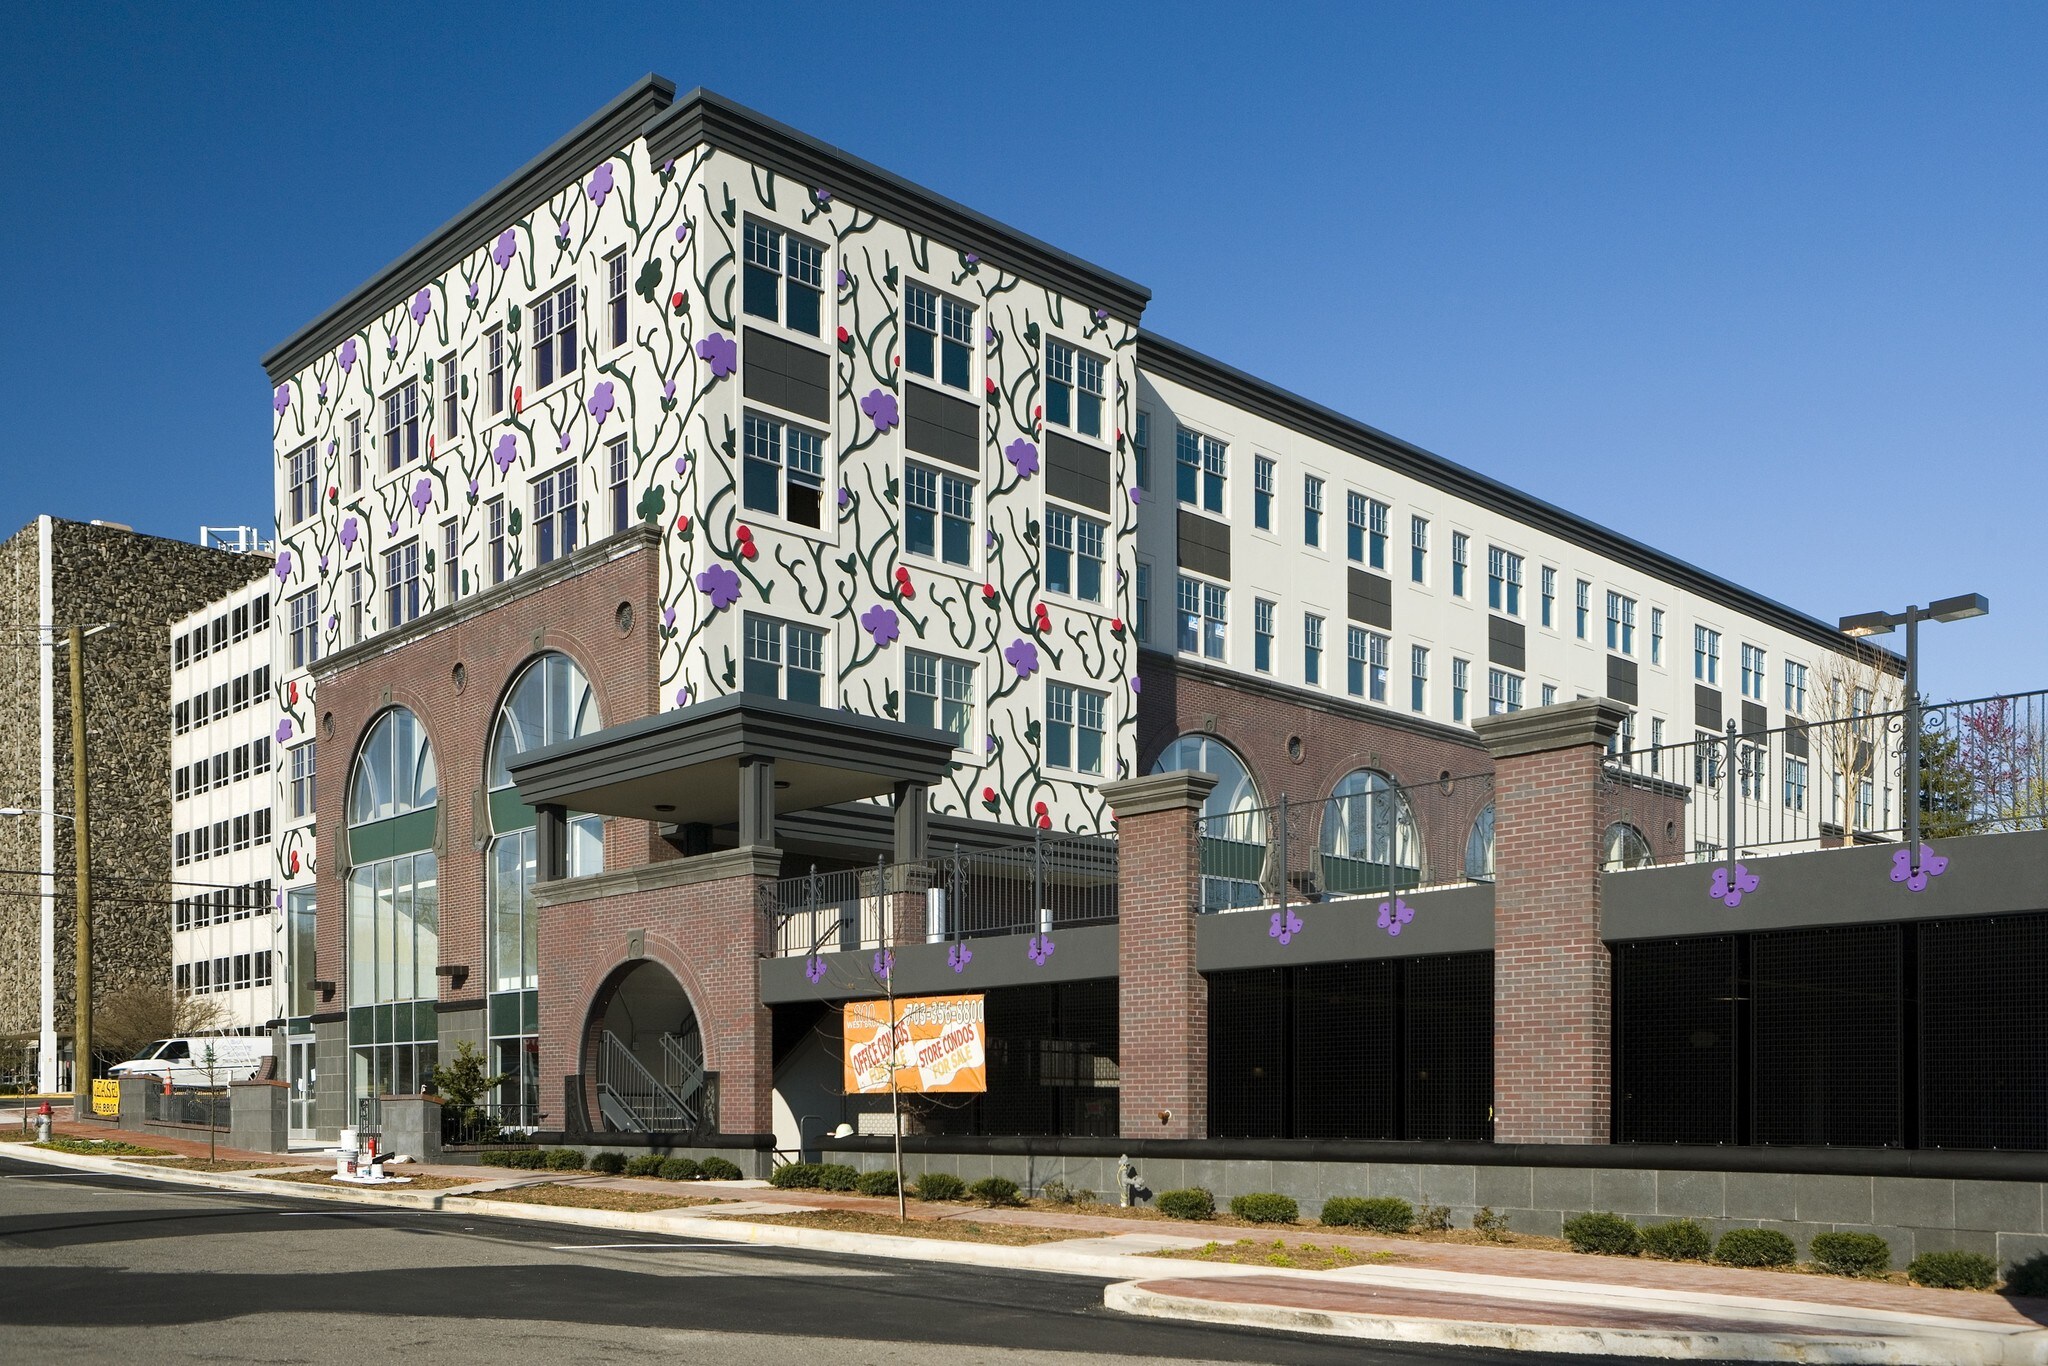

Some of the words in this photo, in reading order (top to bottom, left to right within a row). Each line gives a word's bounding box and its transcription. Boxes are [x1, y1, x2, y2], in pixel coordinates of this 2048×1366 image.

[847, 1020, 863, 1029] WEST
[853, 1003, 876, 1022] 800
[906, 999, 984, 1026] 703-356-8800
[853, 1042, 880, 1076] OFFICE
[918, 1040, 942, 1068] STORE
[942, 1023, 975, 1058] CONDOS
[932, 1060, 952, 1079] FOR
[951, 1044, 973, 1070] SALE
